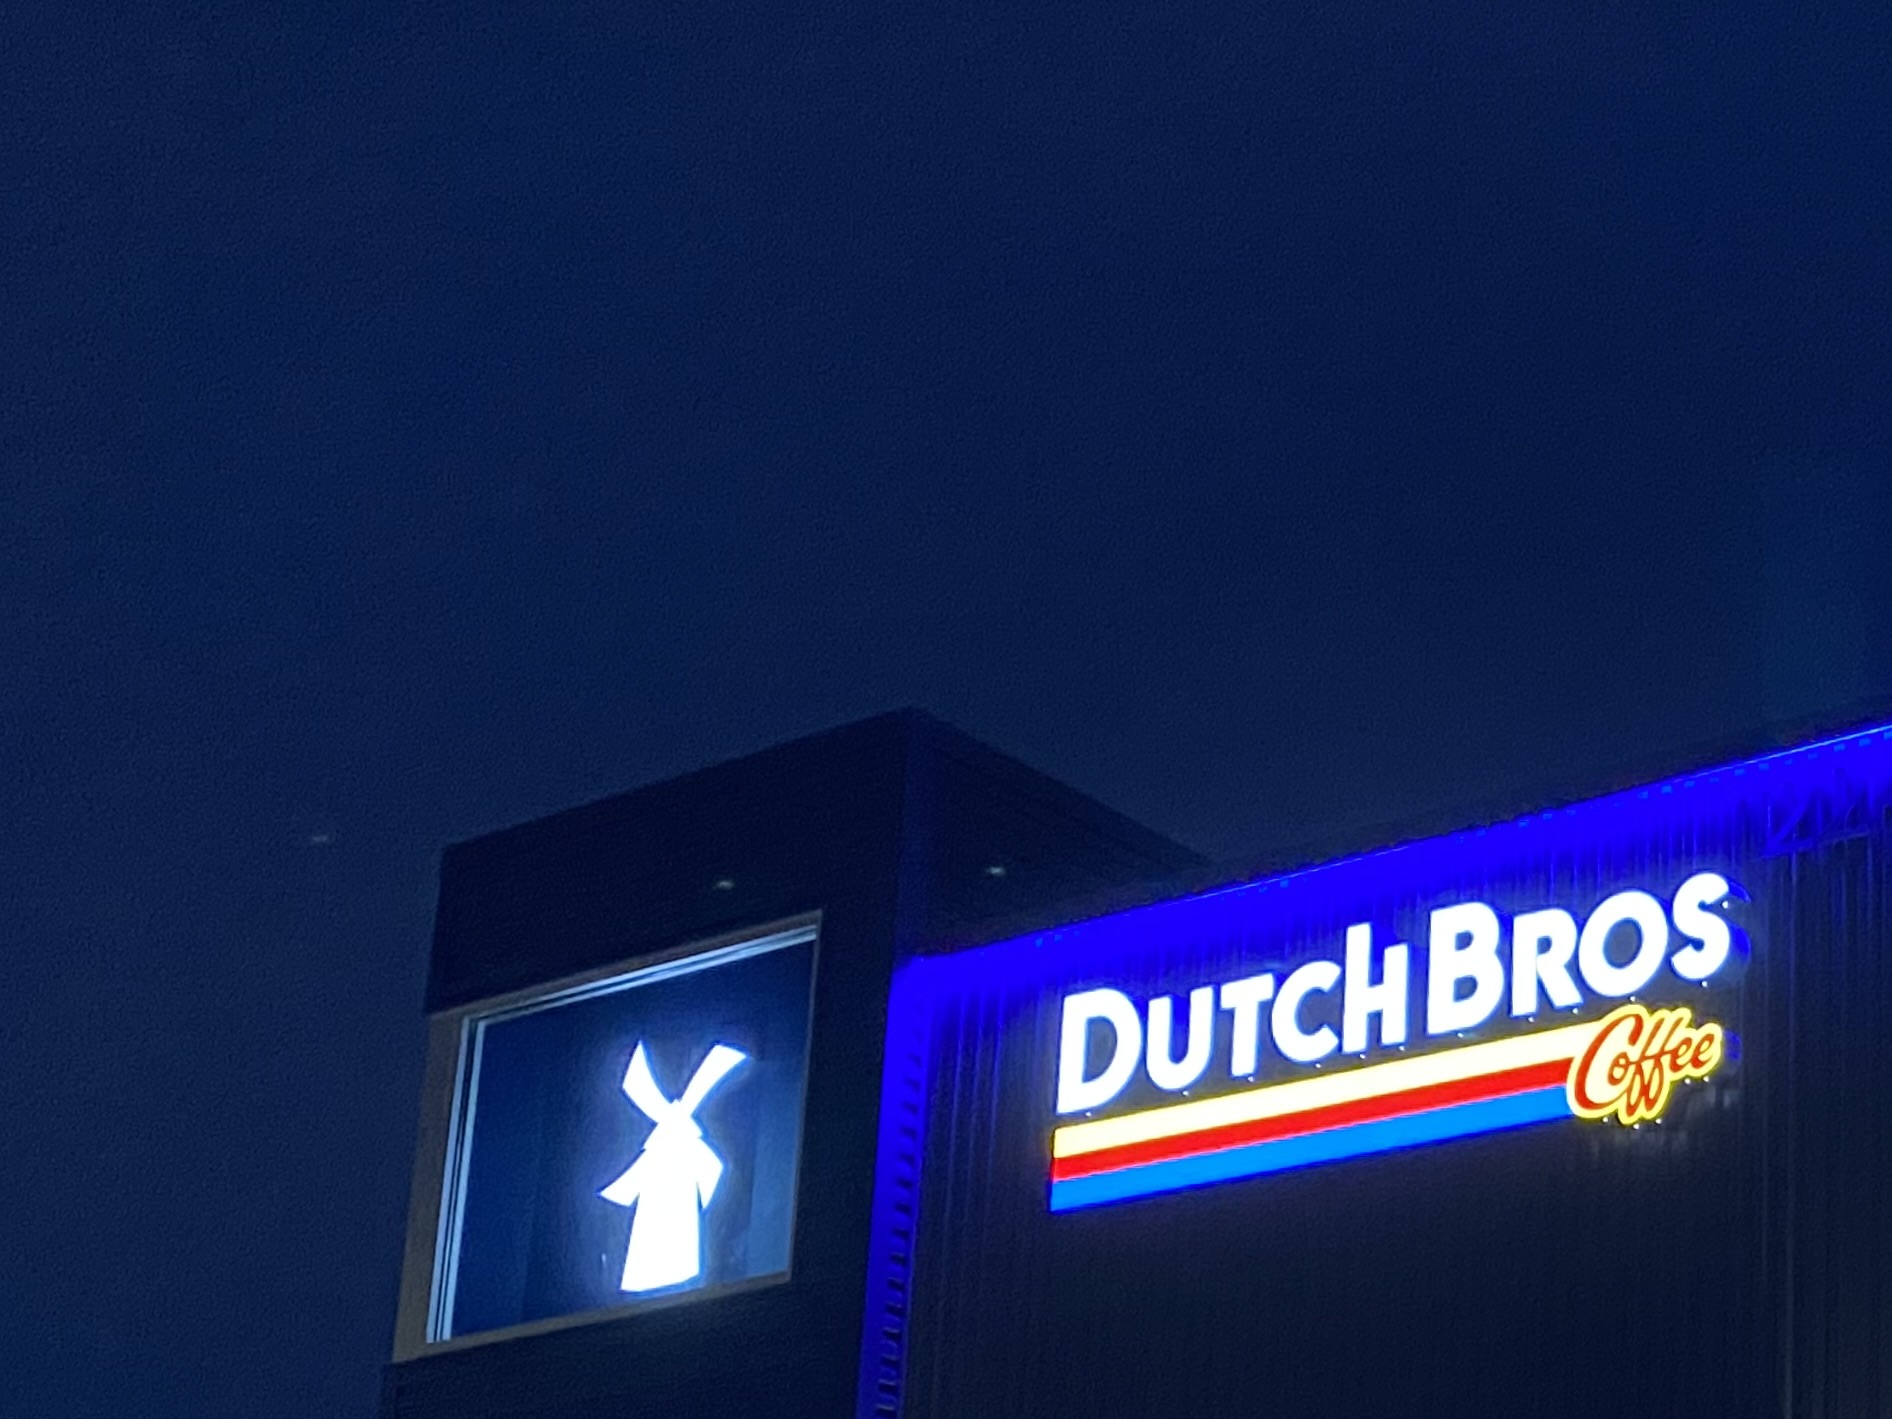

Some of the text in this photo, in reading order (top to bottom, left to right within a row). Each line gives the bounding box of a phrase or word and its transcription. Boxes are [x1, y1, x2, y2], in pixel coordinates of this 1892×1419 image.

[1056, 871, 1732, 1115] DUTCH BROS
[1569, 1008, 1720, 1121] Coffee
